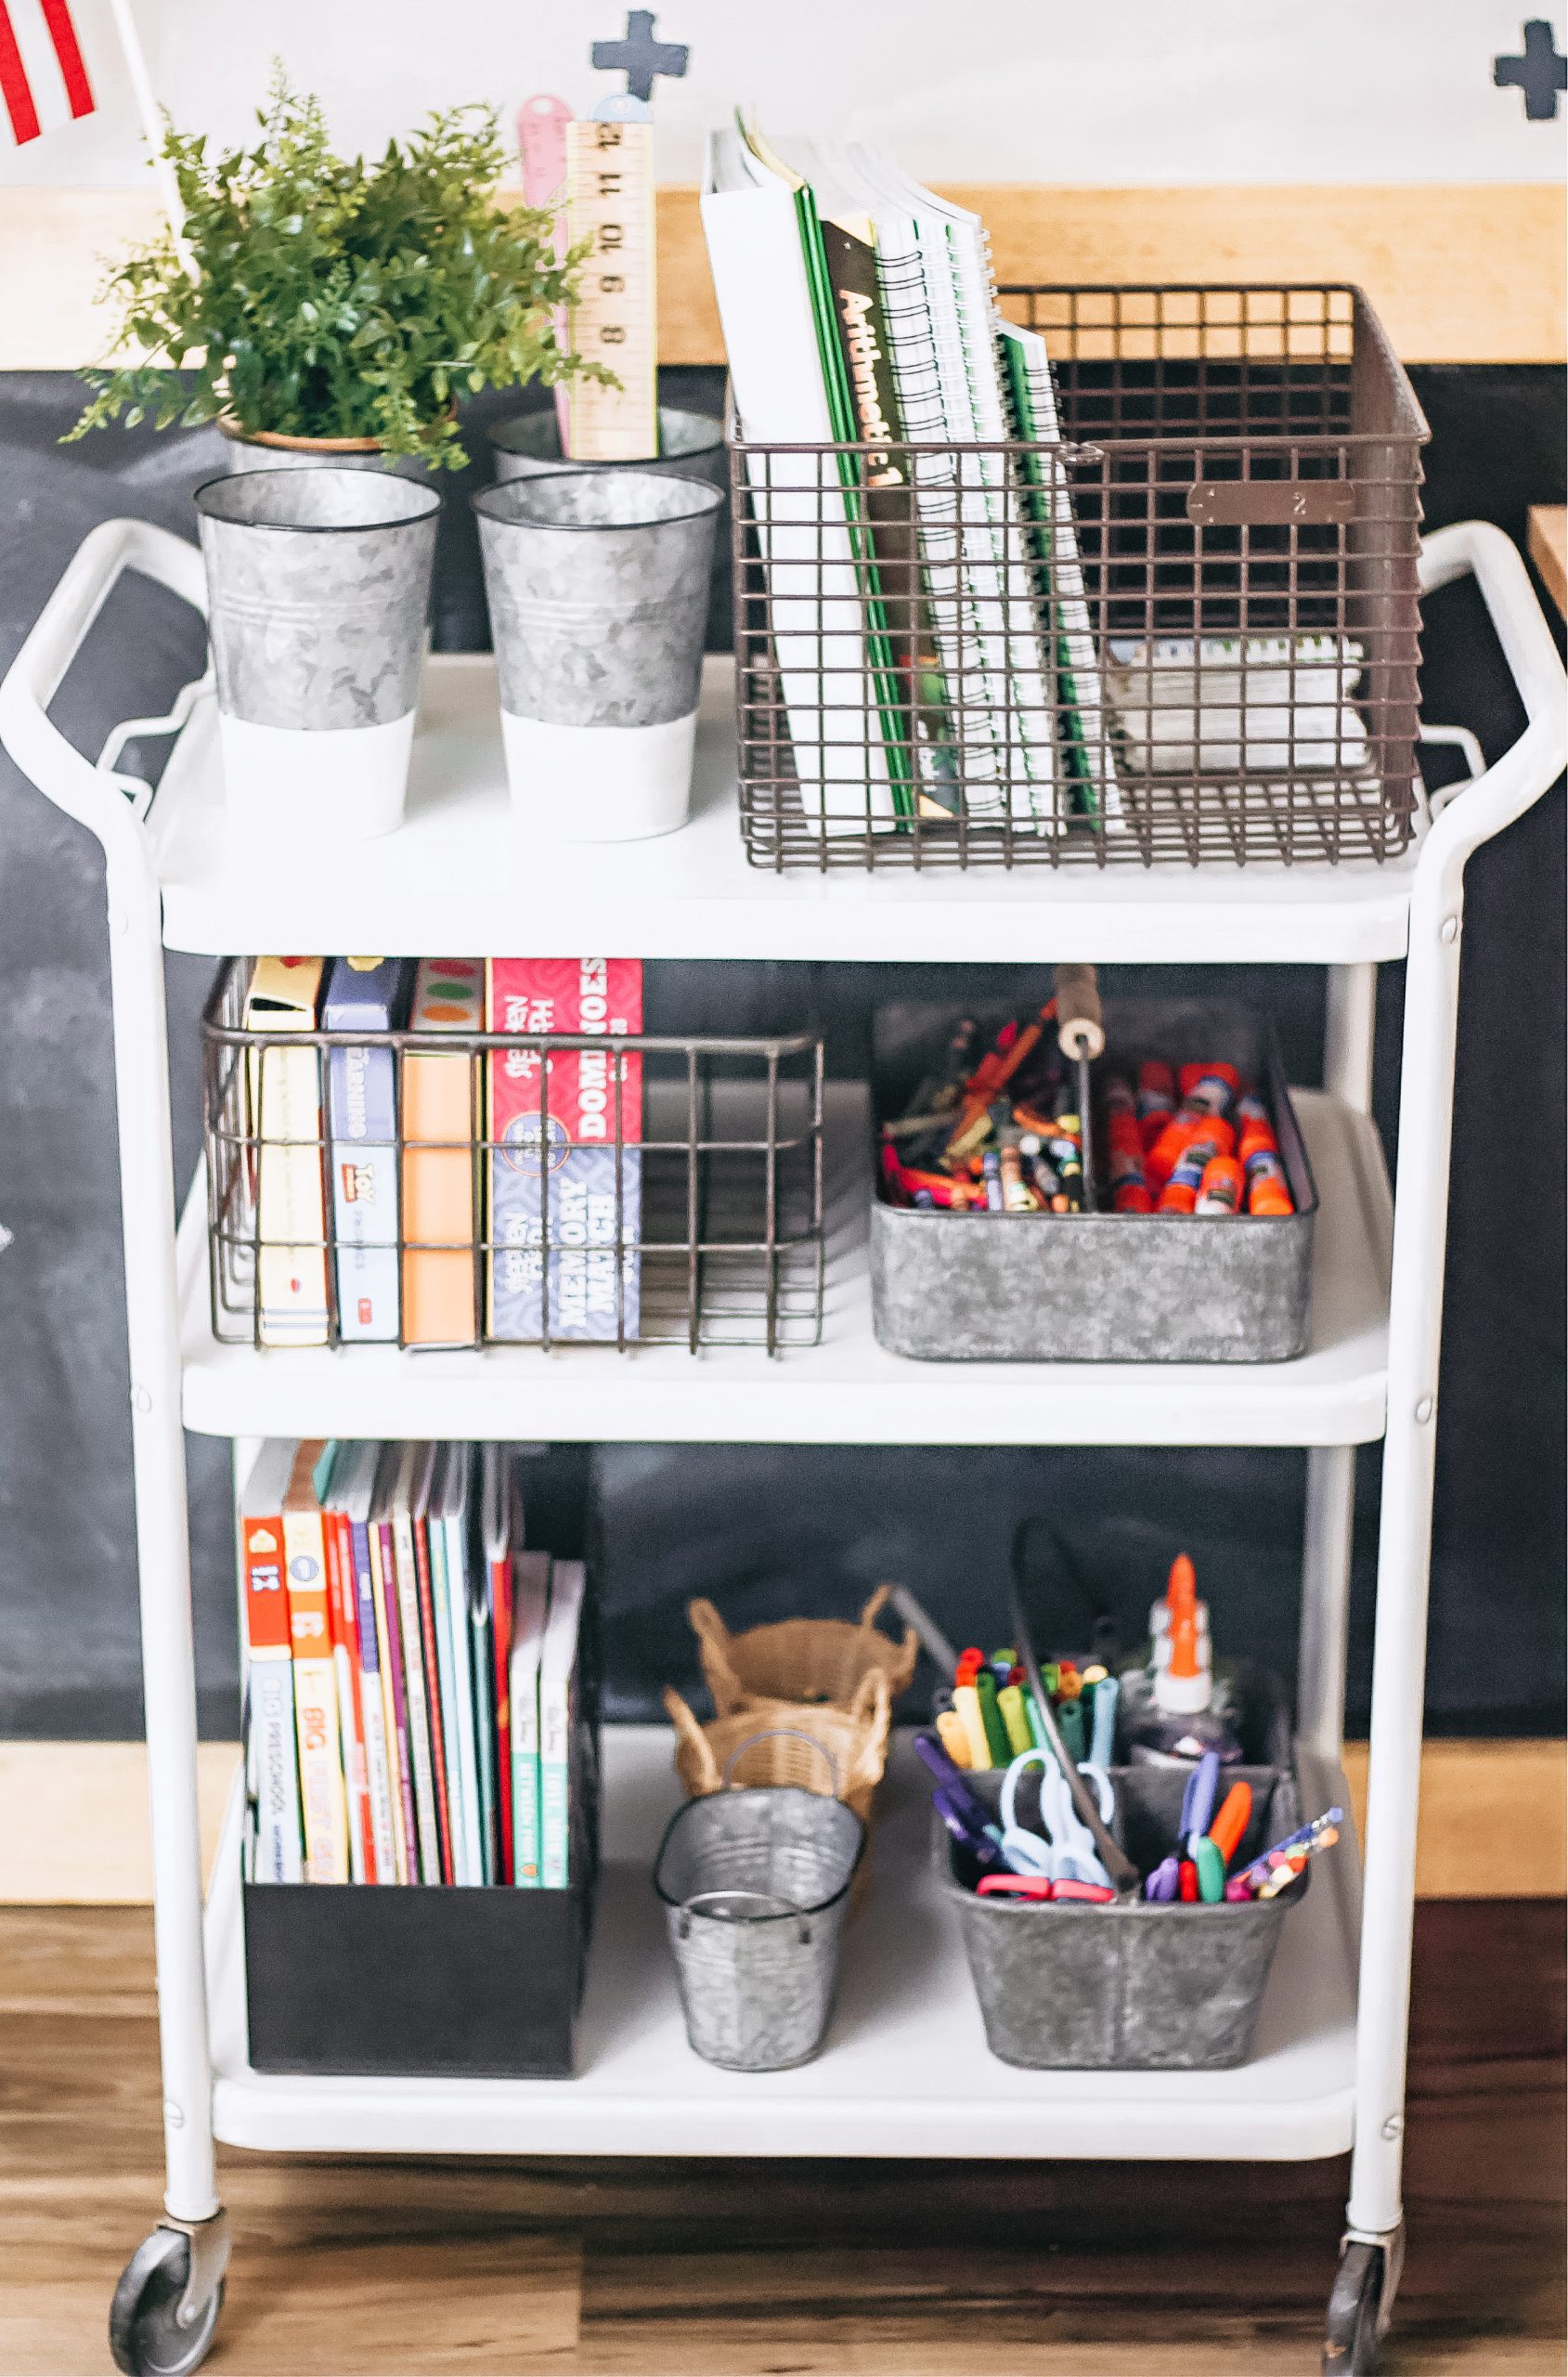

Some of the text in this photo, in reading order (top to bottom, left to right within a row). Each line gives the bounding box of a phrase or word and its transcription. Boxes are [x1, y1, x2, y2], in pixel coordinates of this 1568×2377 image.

[597, 173, 622, 198] 11
[599, 223, 624, 253] 10
[600, 275, 625, 293] 9
[600, 326, 625, 344] 8
[838, 289, 904, 487] Arithmetic 1
[356, 1163, 378, 1203] TOY
[559, 1176, 588, 1327] MEMORY
[303, 1708, 327, 1751] BIG
